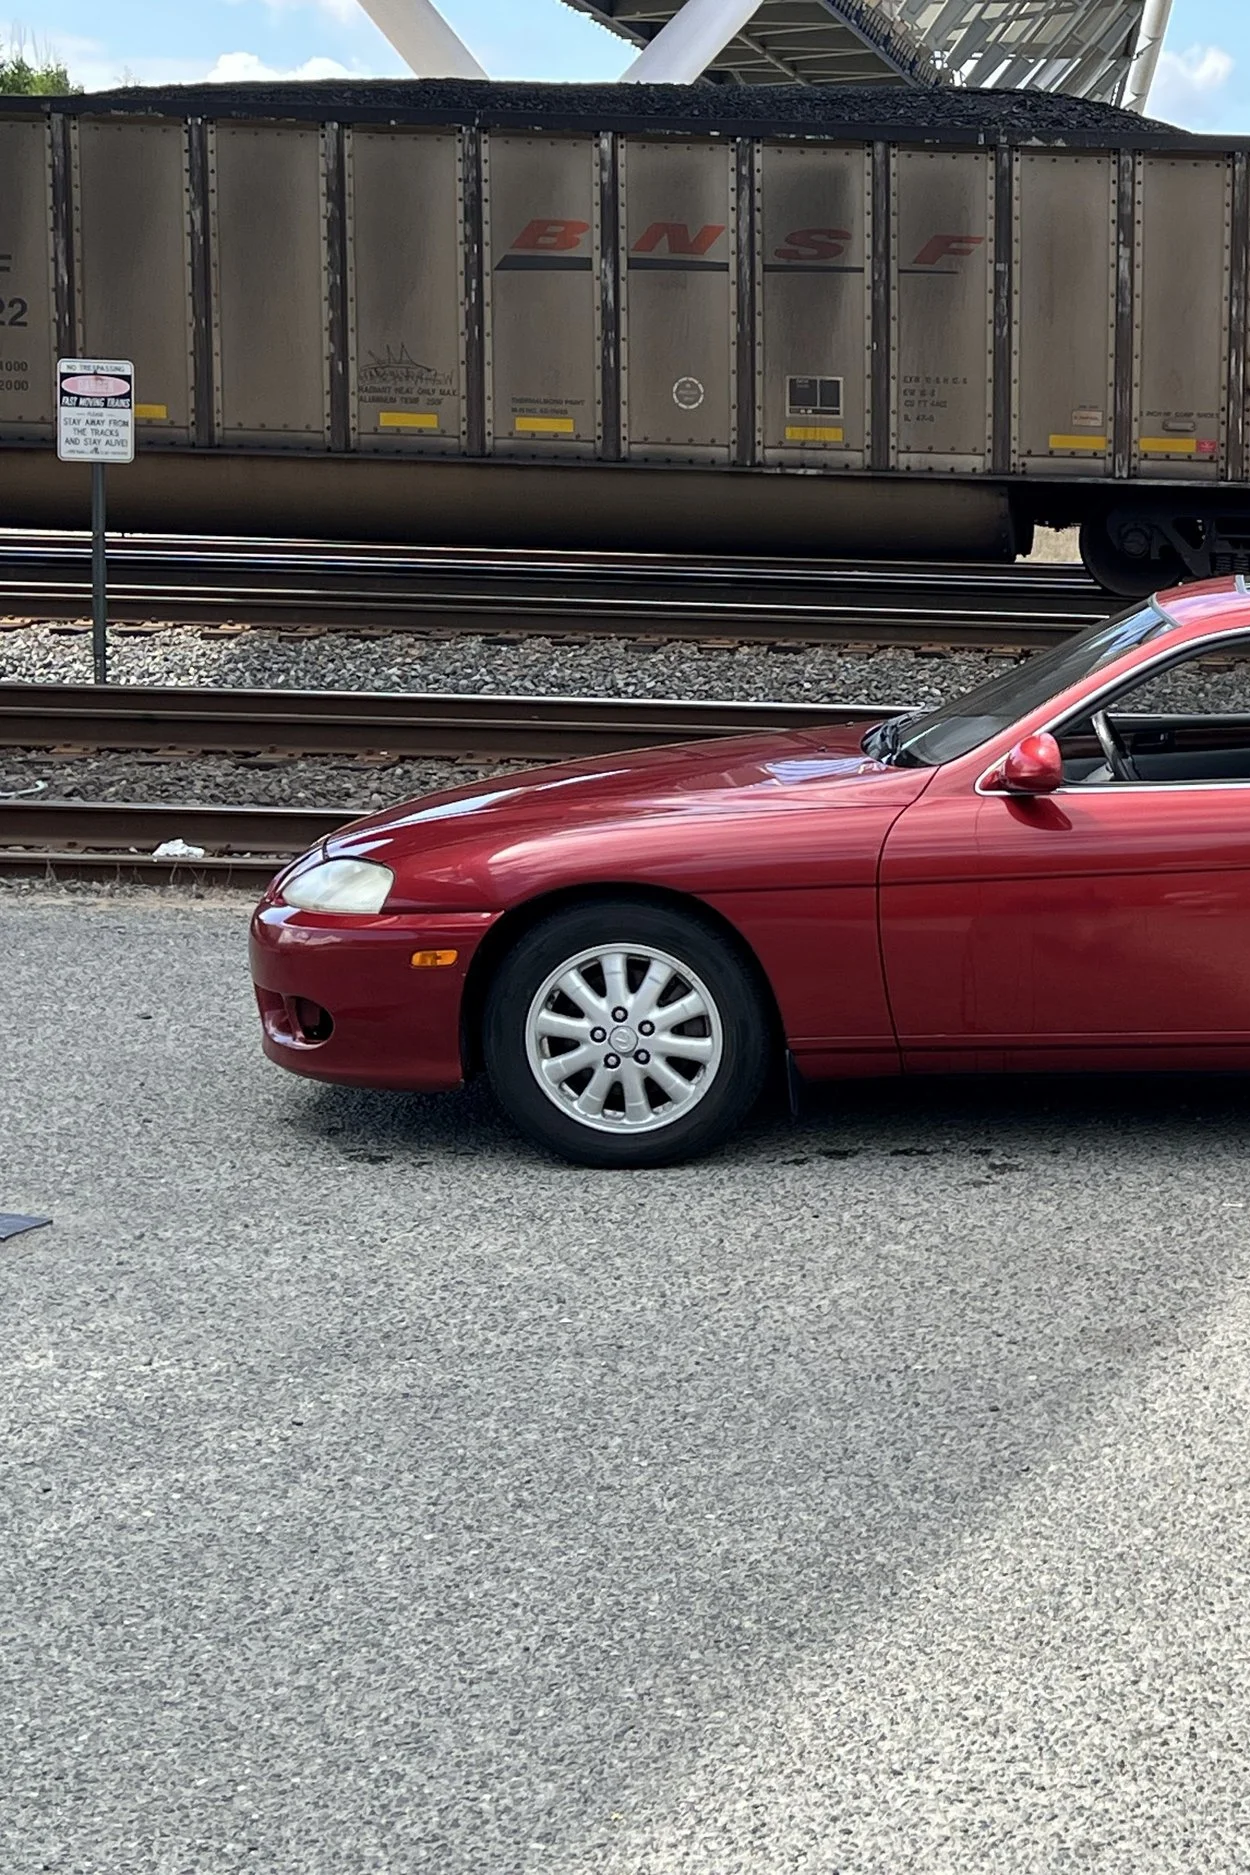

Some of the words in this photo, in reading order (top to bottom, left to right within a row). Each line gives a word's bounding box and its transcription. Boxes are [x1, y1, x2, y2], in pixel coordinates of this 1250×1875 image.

[509, 219, 591, 251] B
[630, 222, 726, 255] N
[774, 228, 852, 260] S
[912, 234, 984, 265] F
[417, 388, 436, 396] ONLY
[61, 396, 78, 406] FAST
[78, 397, 105, 407] MOVING
[106, 398, 131, 408] TRAINS
[63, 417, 81, 426] STAY
[73, 428, 87, 436] THE
[90, 429, 120, 437] TRACKS
[64, 437, 80, 445] AND
[105, 440, 128, 448] ALIVE!
